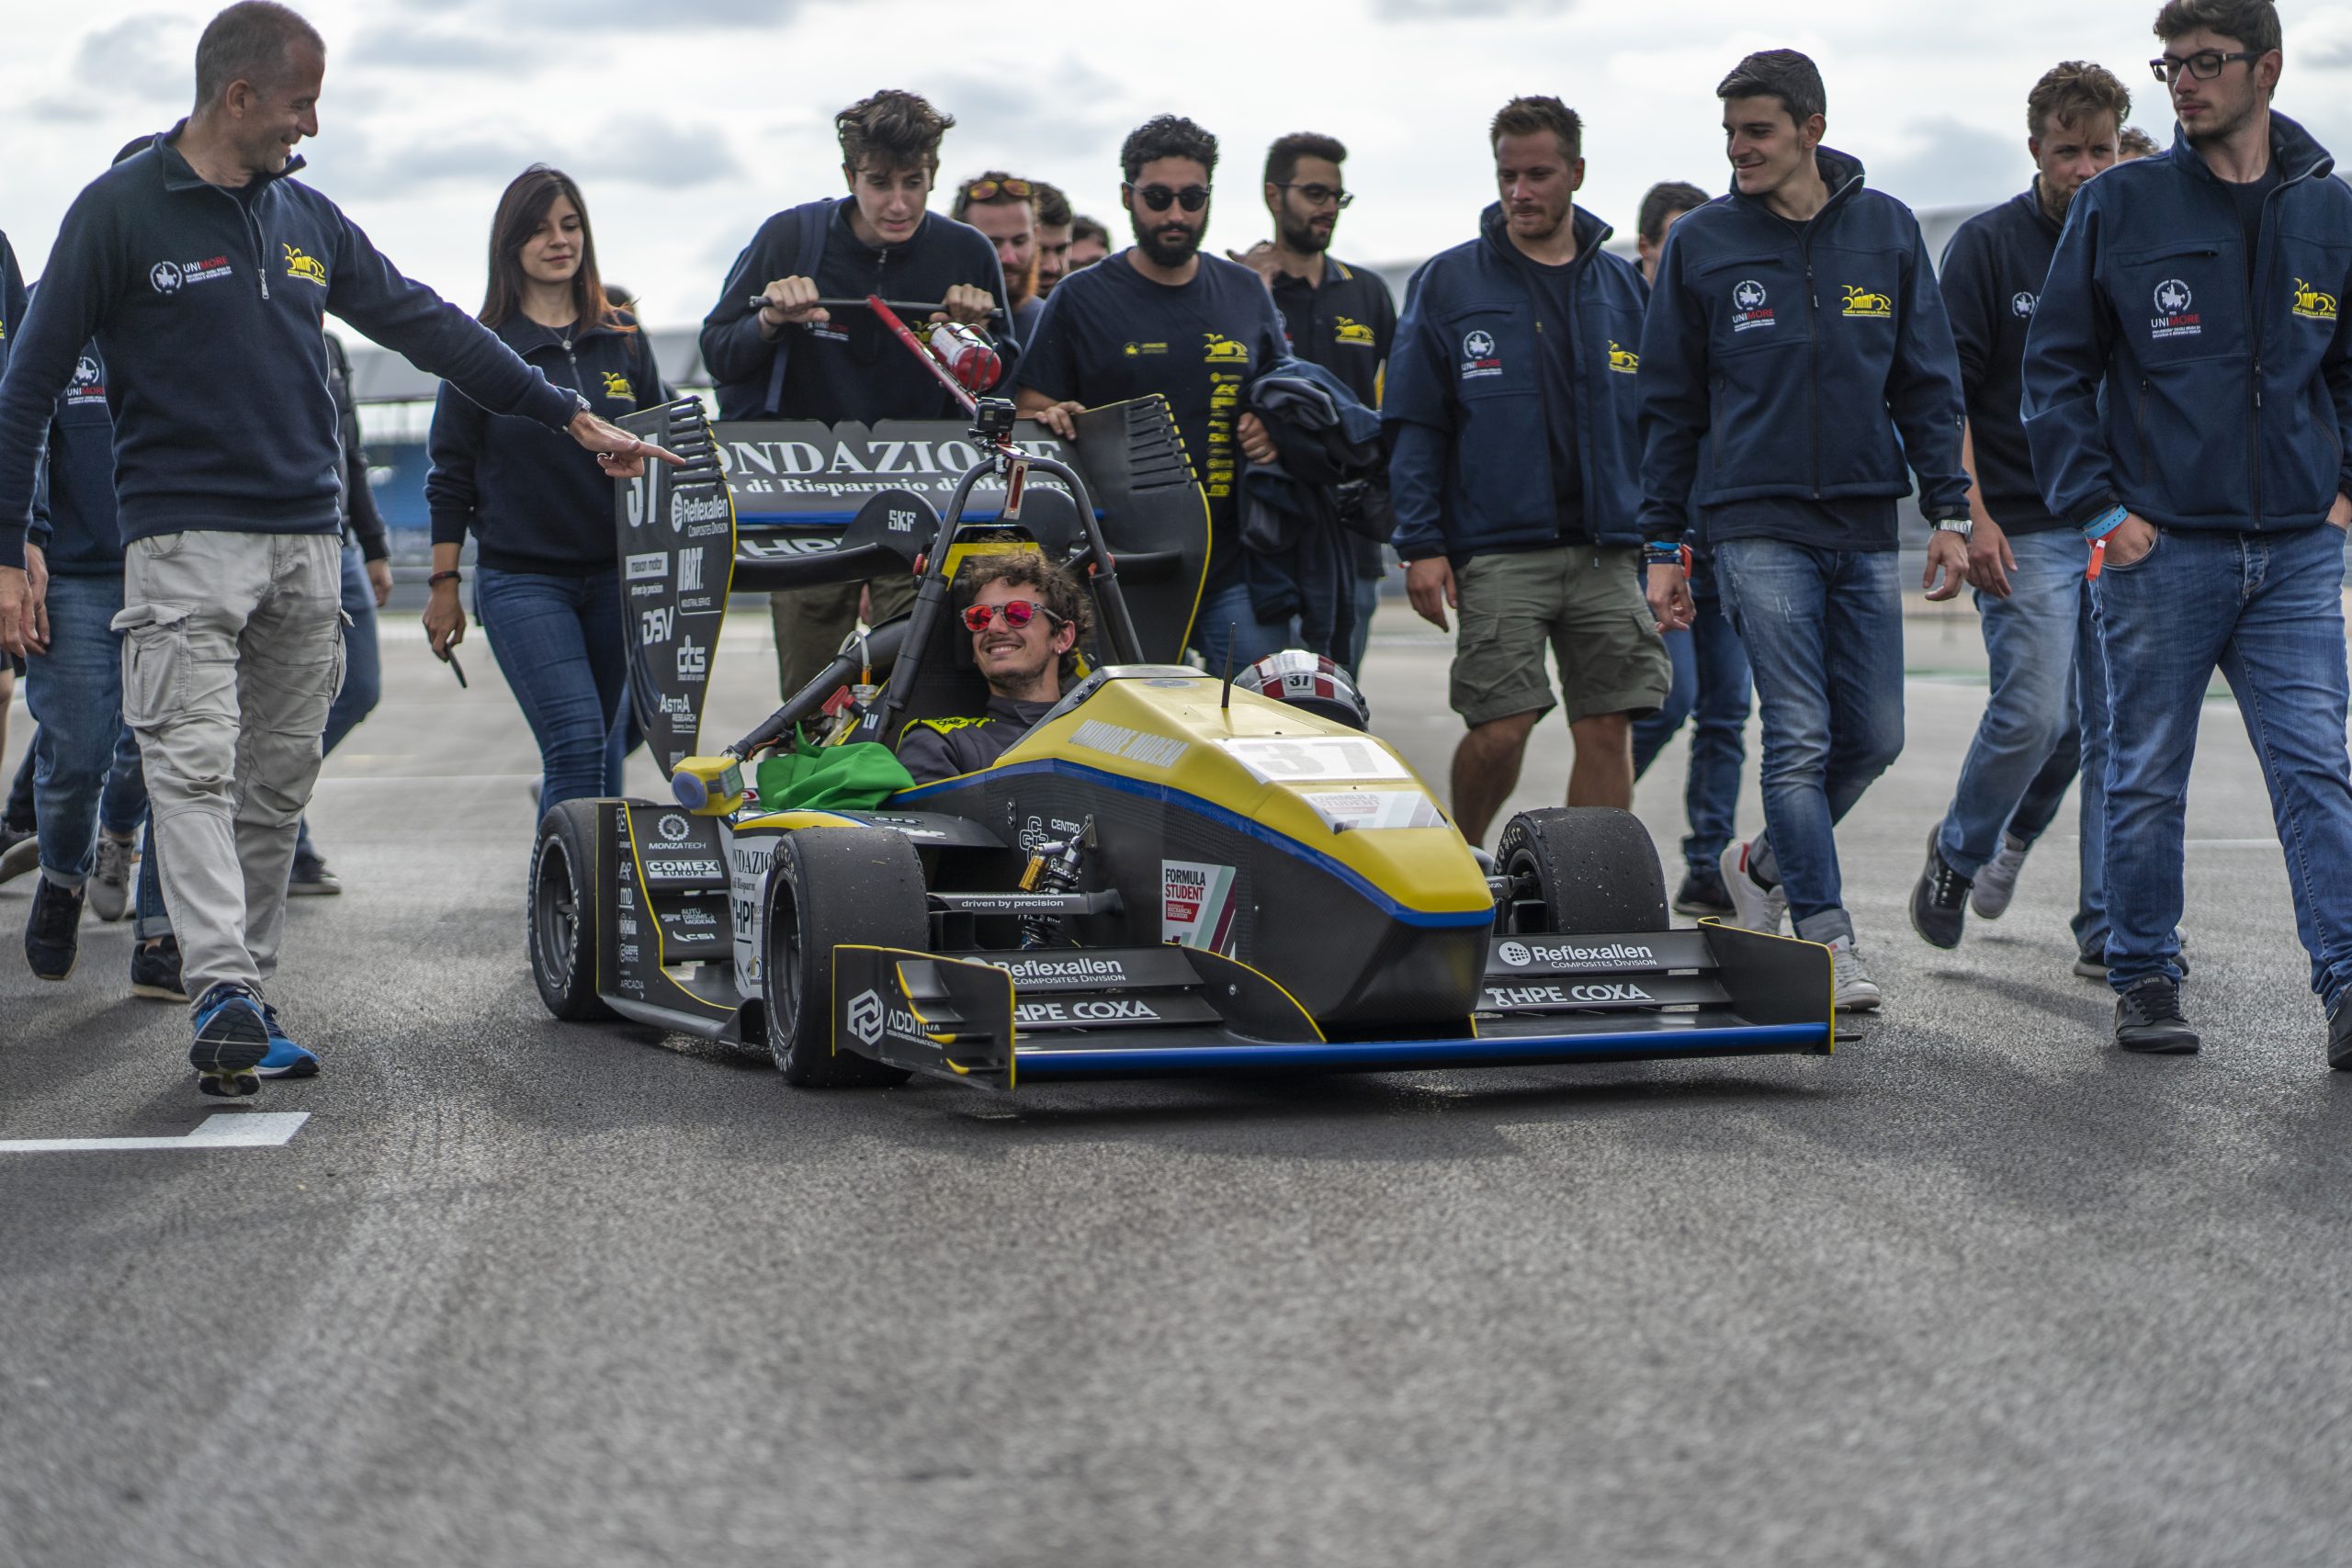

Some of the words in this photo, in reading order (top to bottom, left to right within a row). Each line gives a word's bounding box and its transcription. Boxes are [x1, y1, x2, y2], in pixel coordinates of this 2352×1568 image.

[182, 255, 230, 274] UNIMORE
[1732, 309, 1775, 323] UNIMORE
[2151, 313, 2201, 328] UNIMORE
[1461, 358, 1501, 371] UNIMORE
[747, 479, 774, 493] di
[777, 478, 931, 498] Risparmio
[683, 494, 729, 523] Reflexallen
[888, 509, 917, 533] SKF
[642, 606, 674, 646] DSV
[862, 713, 879, 730] LV
[1050, 818, 1080, 835] CENTRO
[648, 841, 707, 851] MONZATECH
[649, 861, 718, 872] COMEX
[1165, 868, 1206, 886] FORMULA
[1165, 883, 1204, 901] STUDENT
[961, 899, 993, 908] driven
[998, 899, 1012, 909] by
[1014, 899, 1065, 910] precision
[1531, 942, 1653, 963] Reflexallen
[1550, 959, 1612, 969] COMPOSITES
[1614, 957, 1657, 967] DIVISION
[620, 979, 645, 989] ARCADIA
[1012, 976, 1078, 986] COMPOSITES
[1080, 974, 1126, 983] DIVISION
[1571, 983, 1653, 1001] COXA
[1073, 999, 1159, 1020] COXA
